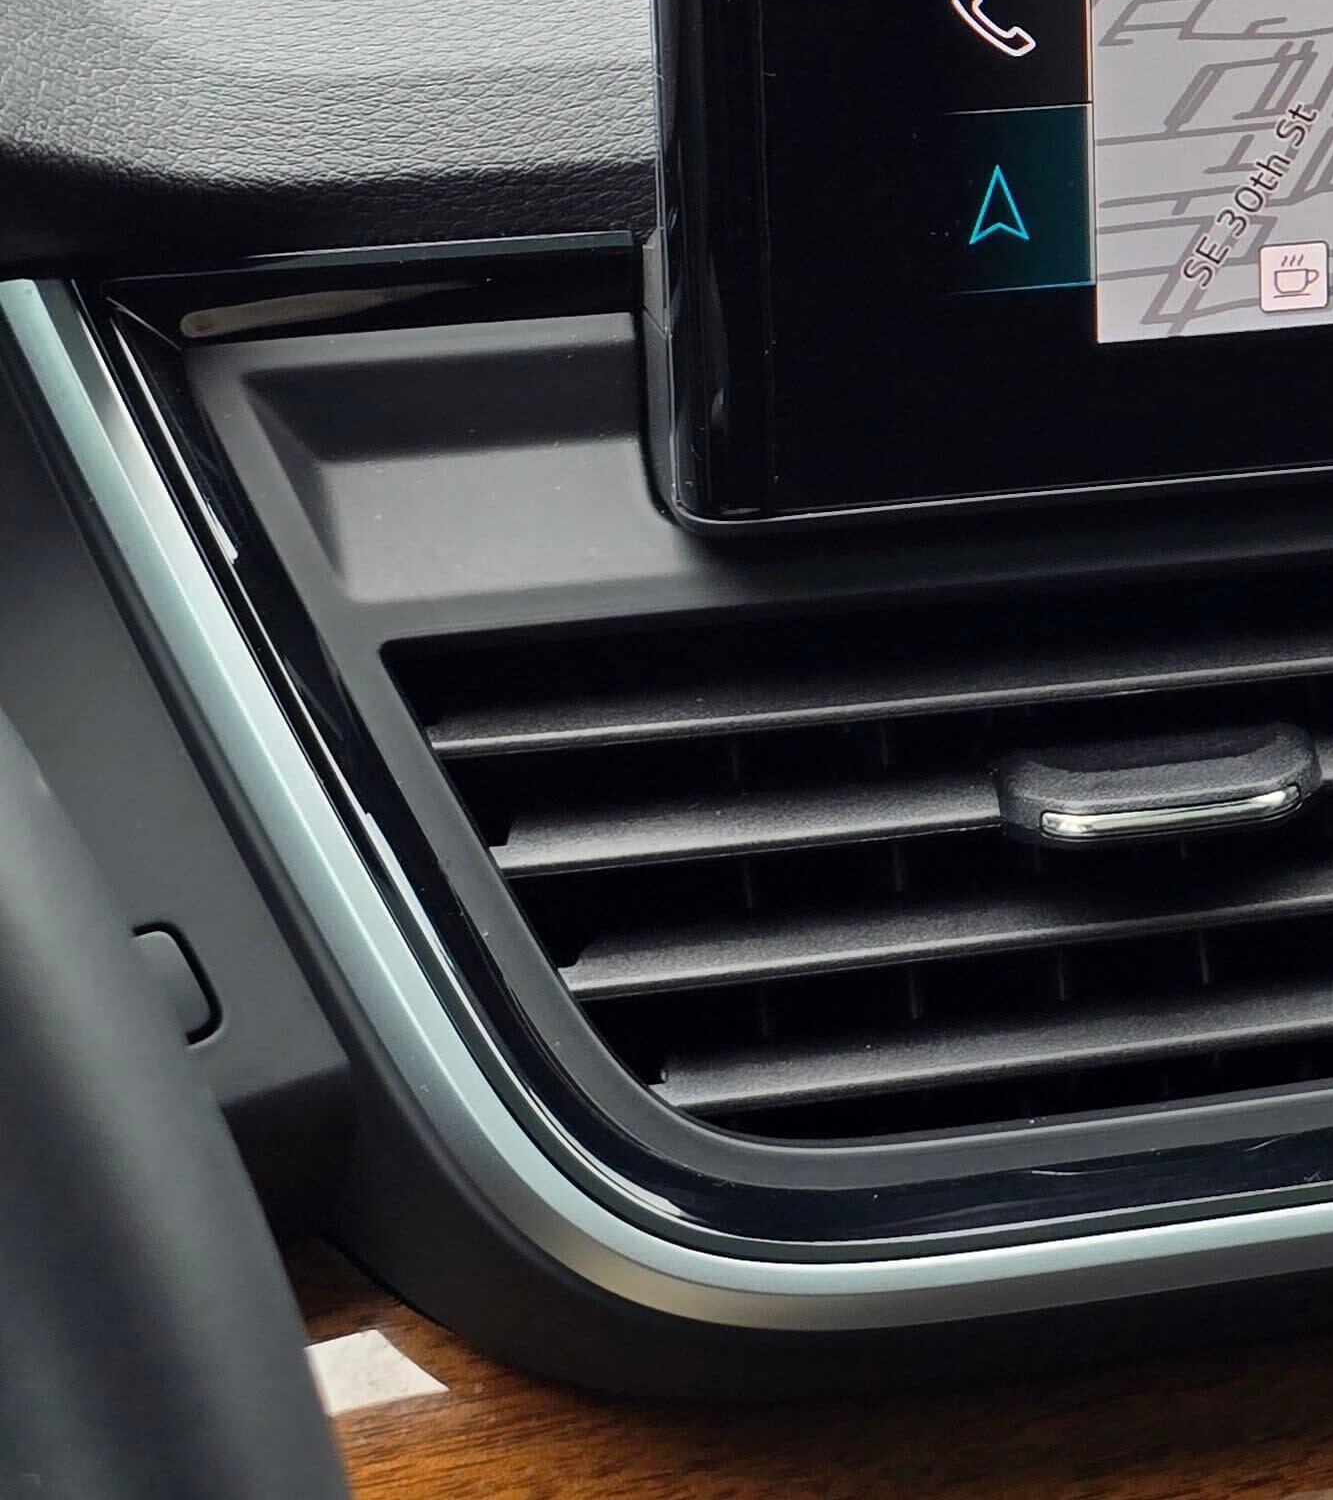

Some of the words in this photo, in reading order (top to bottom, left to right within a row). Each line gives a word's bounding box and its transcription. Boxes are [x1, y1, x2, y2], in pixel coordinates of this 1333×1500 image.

[1182, 235, 1230, 288] SE
[1215, 153, 1291, 238] 30th
[1275, 103, 1318, 147] St
